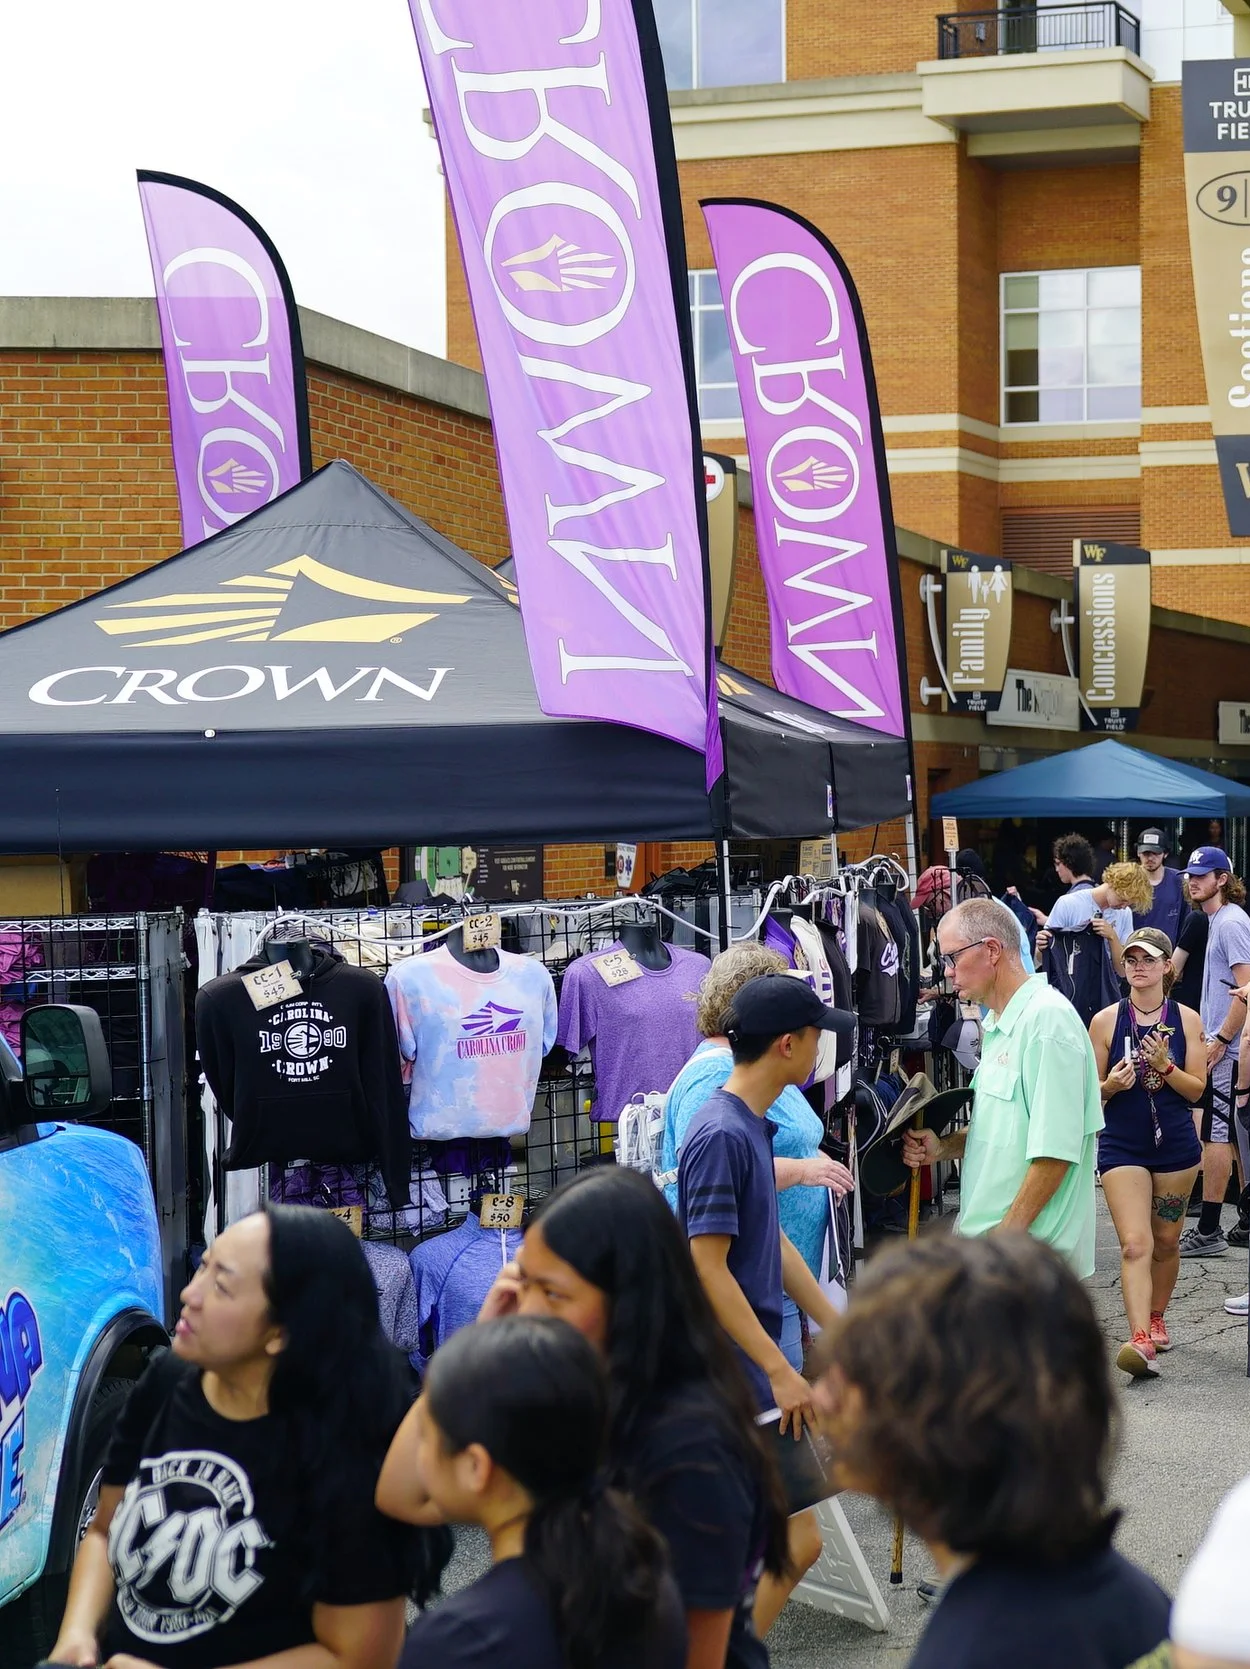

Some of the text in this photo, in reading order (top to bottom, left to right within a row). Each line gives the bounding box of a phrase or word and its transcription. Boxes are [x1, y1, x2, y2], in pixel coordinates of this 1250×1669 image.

[162, 247, 286, 538] CRO
[730, 252, 886, 718] CROWN
[1083, 545, 1106, 562] WF
[953, 608, 991, 685] Family
[1086, 572, 1115, 701] Concessions
[28, 664, 454, 707] CROWN
[472, 933, 489, 943] $45
[264, 983, 285, 998] $45
[457, 1037, 500, 1059] CAROLINA
[490, 1213, 510, 1223] $50
